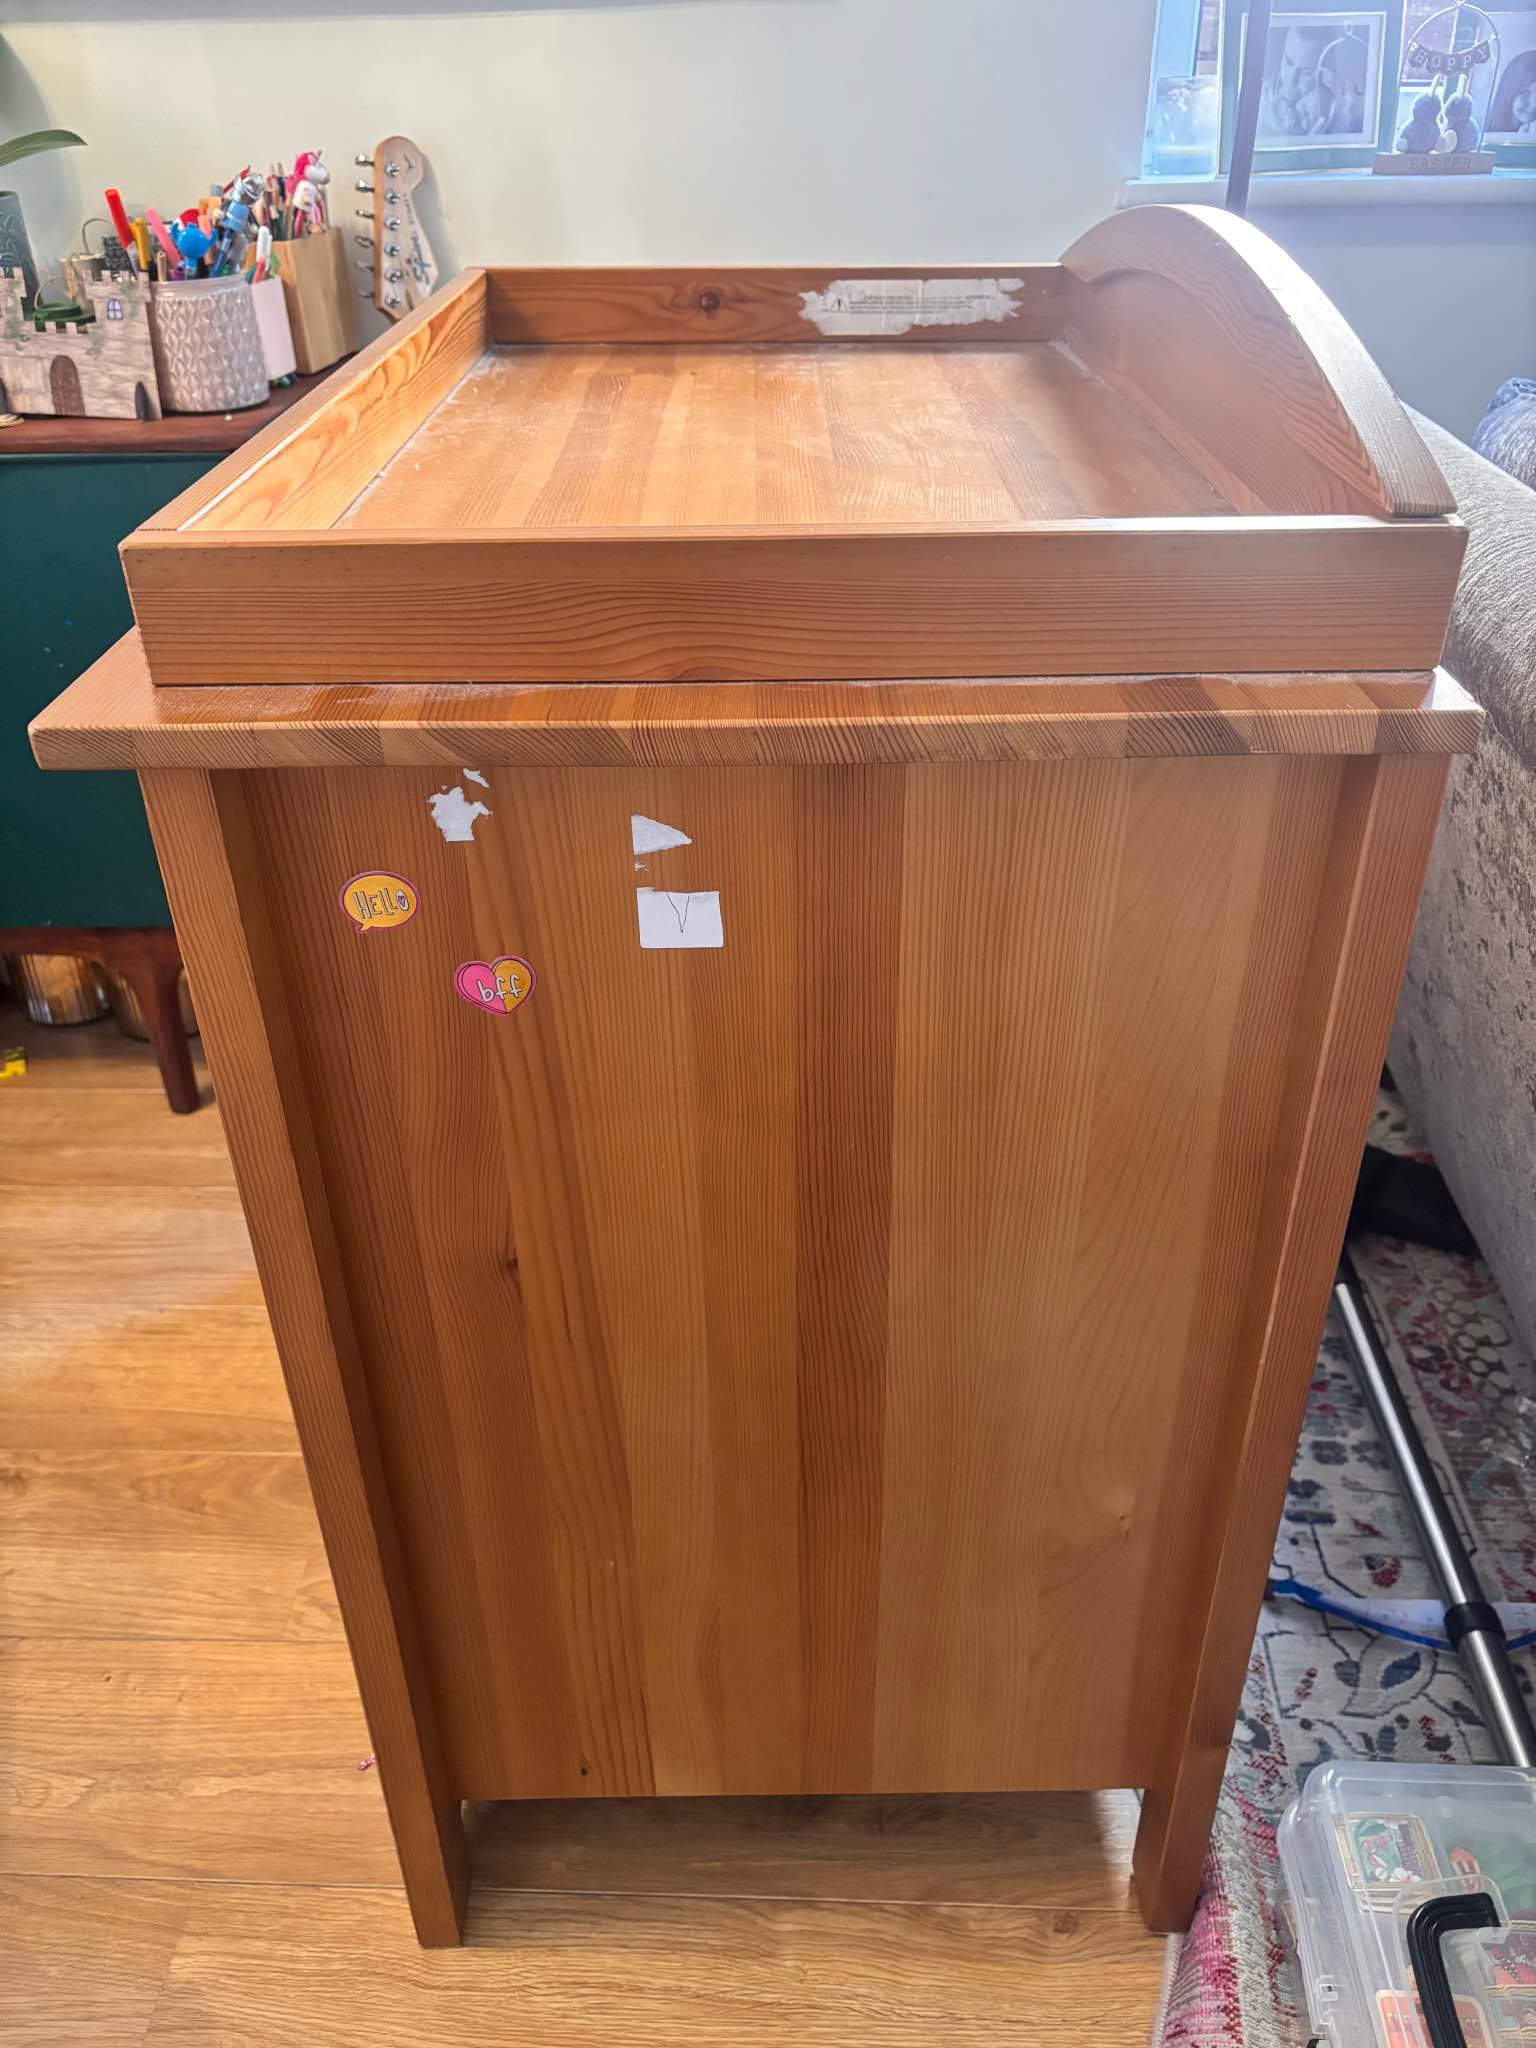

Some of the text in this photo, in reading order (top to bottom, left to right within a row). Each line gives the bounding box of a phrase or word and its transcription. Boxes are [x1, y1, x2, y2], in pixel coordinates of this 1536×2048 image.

[1414, 45, 1487, 70] HOPPY
[1409, 156, 1472, 170] EASTER
[352, 887, 410, 920] HELLO
[476, 973, 523, 1002] bff
